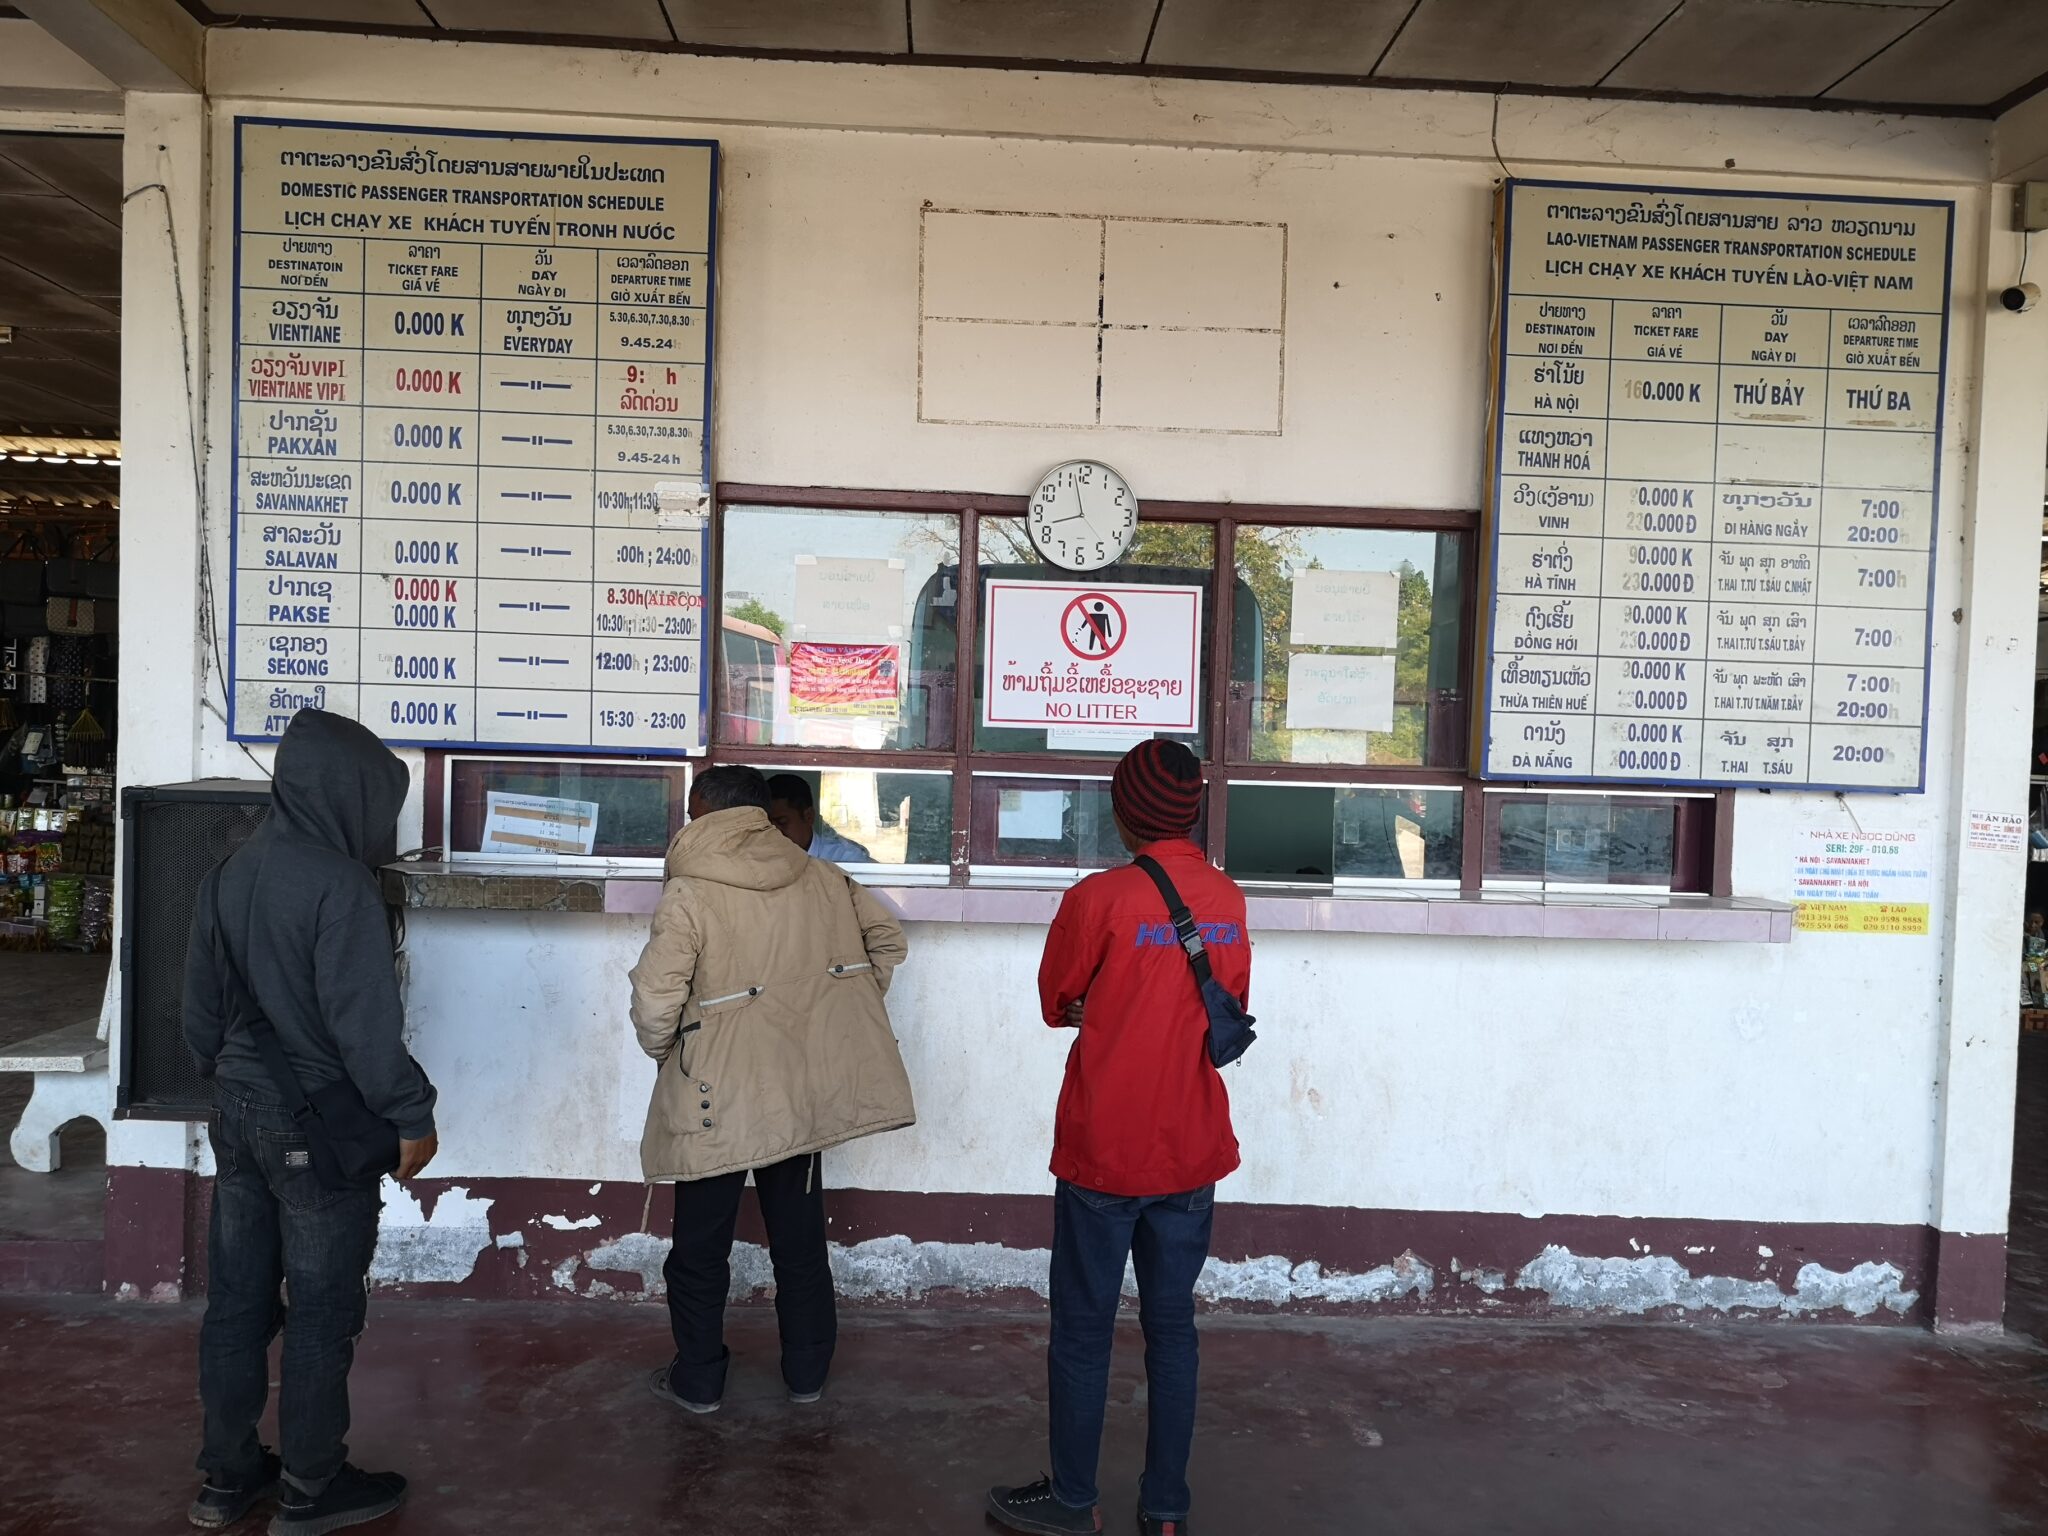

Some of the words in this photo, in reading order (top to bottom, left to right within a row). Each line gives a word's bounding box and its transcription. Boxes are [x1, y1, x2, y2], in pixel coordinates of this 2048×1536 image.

[281, 182, 356, 198] DOMESTIC
[362, 185, 447, 203] PASSENGER
[452, 189, 583, 208] TRANSPORTATION
[588, 195, 665, 211] SCHEDULE
[285, 211, 324, 230] LỊCH
[331, 213, 382, 232] CHẠY
[388, 216, 412, 230] XE
[424, 212, 484, 233] KHÁCH
[490, 214, 551, 235] TUYẾN
[557, 222, 617, 238] TRONH
[623, 222, 675, 240] NƯỚC
[1788, 217, 1823, 232] ລາວ
[1547, 232, 1638, 249] LAO-VIETNAM
[1642, 237, 1720, 254] PASSENGER
[1724, 241, 1843, 259] TRANSPORTATION
[1847, 247, 1917, 262] SCHEDULE
[269, 259, 343, 272] DESTINATOIN
[388, 264, 428, 276] TICKET
[431, 266, 459, 277] FARE
[532, 271, 558, 281] DAY
[611, 274, 667, 286] DEPARTURE
[669, 277, 692, 287] TIME
[1546, 260, 1583, 276] LỊCH
[1589, 262, 1637, 280] CHẠY
[1642, 265, 1664, 278] XE
[1670, 264, 1726, 282] KHÁCH
[1732, 264, 1788, 285] TUYẾN
[1875, 276, 1913, 290] NAM
[402, 278, 421, 291] GIÁ
[518, 283, 551, 297] NGÀY
[272, 296, 339, 321] ວຽງຈັນ
[395, 311, 445, 336] 0.000
[451, 313, 465, 336] K
[1525, 323, 1596, 337] DESTINATOIN
[1634, 325, 1670, 337] TICKET
[1673, 327, 1699, 338] FARE
[269, 323, 341, 343] VIENTIANE
[1764, 332, 1789, 343] DAY
[1844, 335, 1895, 347] DEPARTURE
[1898, 338, 1919, 348] TIME
[504, 336, 573, 354] EVERYDAY
[1647, 344, 1666, 357] GIÁ
[249, 379, 313, 399] VIENTIANE
[396, 368, 443, 393] 0.000
[449, 371, 462, 394] K
[1535, 393, 1552, 409] HÀ
[1689, 383, 1701, 403] K
[1734, 378, 1767, 405] THỨ
[1772, 379, 1805, 406] BẢY
[1847, 385, 1882, 410] THỨ
[1887, 391, 1911, 411] BA
[394, 424, 443, 448] 0.000
[449, 427, 463, 449] K
[268, 437, 337, 456] PAKXAN
[1518, 451, 1561, 469] THANH
[1564, 451, 1591, 470] HOÁ
[1059, 472, 1072, 488] 11
[1079, 466, 1092, 484] 12
[391, 481, 441, 505] 0.000
[448, 483, 462, 506] K
[1043, 484, 1056, 503] 10
[1115, 488, 1125, 506] 2
[256, 492, 349, 514] SAVANNAKHET
[1034, 504, 1043, 523] 9
[1123, 509, 1133, 527] 3
[1539, 516, 1569, 529] VINH
[1042, 526, 1051, 544] 8
[1740, 520, 1772, 536] HÀNG
[1112, 531, 1122, 546] 4
[395, 541, 440, 564] 0.000
[446, 542, 459, 565] K
[1058, 541, 1065, 557] 7
[1075, 547, 1085, 565] 6
[1096, 542, 1105, 560] 5
[1682, 547, 1692, 566] K
[265, 550, 337, 569] SALAVAN
[395, 578, 440, 601] 0.000
[445, 580, 457, 603] K
[1525, 573, 1542, 590] HÀ
[269, 605, 330, 624] PAKSE
[395, 604, 439, 628] 0.000
[444, 606, 456, 629] K
[268, 659, 328, 676] SEKONG
[395, 655, 439, 680] 0.000
[445, 658, 456, 680] K
[1046, 703, 1072, 718] NO
[1077, 704, 1137, 720] LITTER
[1532, 695, 1562, 710] THIÊN
[391, 701, 438, 725] 0.000
[445, 704, 457, 726] K
[1836, 832, 1848, 841] XE
[1826, 844, 1847, 853] SERI:
[1799, 879, 1842, 887] SAVANNAKHET
